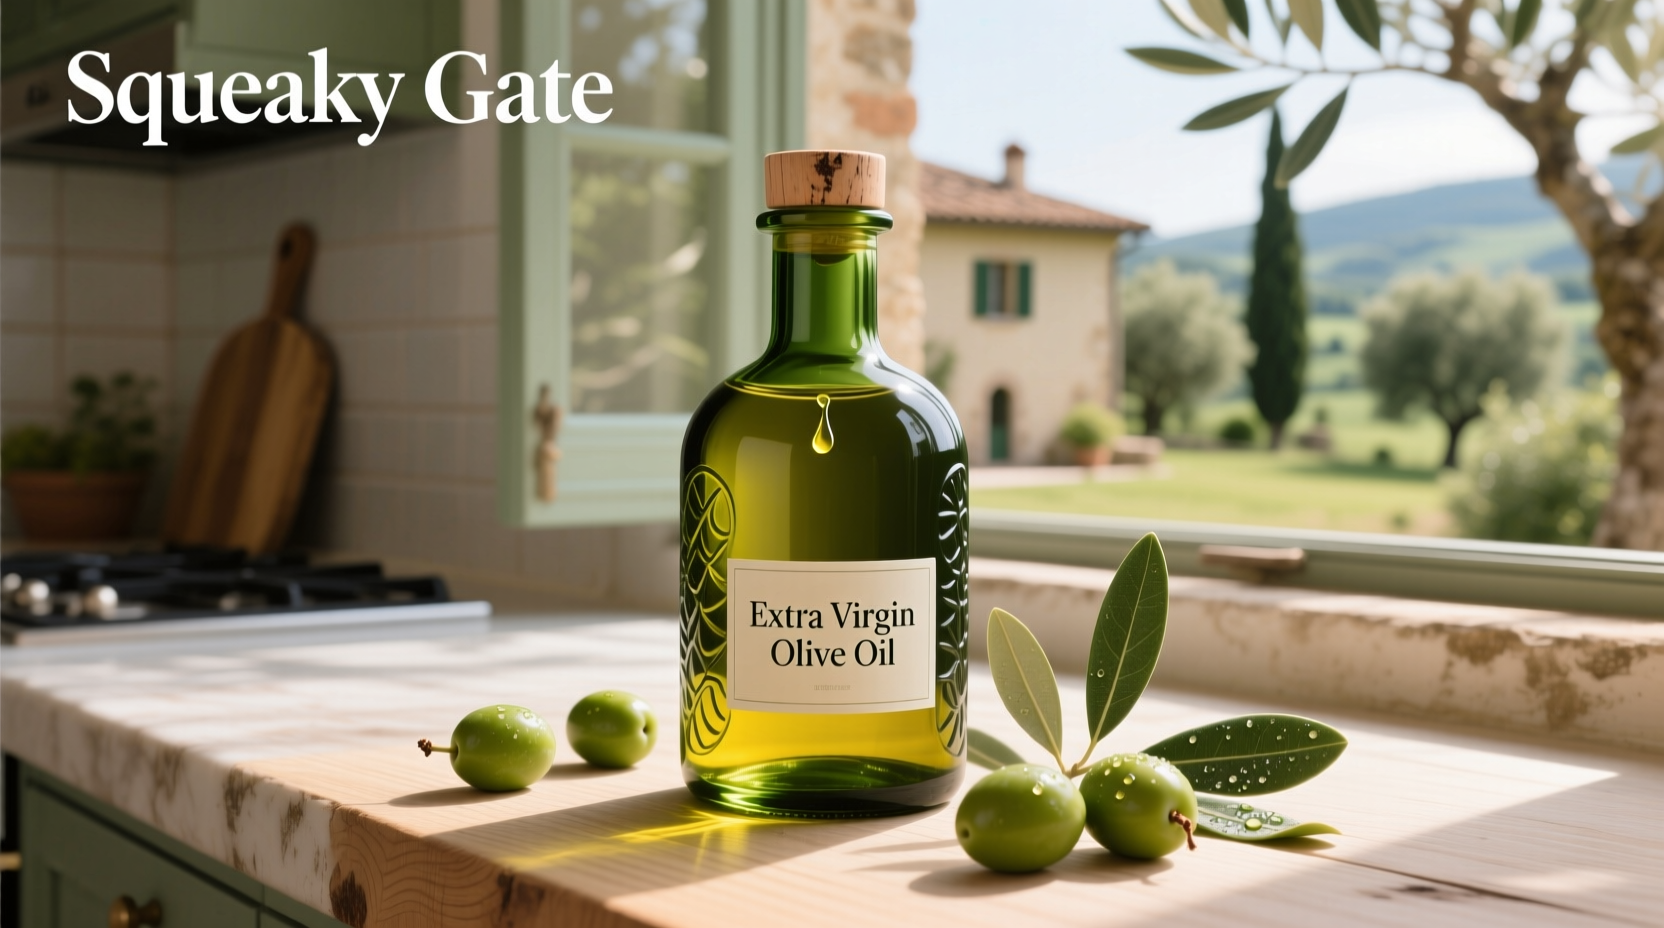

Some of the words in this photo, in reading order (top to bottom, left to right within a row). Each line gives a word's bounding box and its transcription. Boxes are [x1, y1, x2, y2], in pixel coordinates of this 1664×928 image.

[749, 600, 824, 630] Extra
[829, 600, 916, 636] Virgin
[770, 638, 847, 668] Olive
[853, 637, 896, 668] Oil
